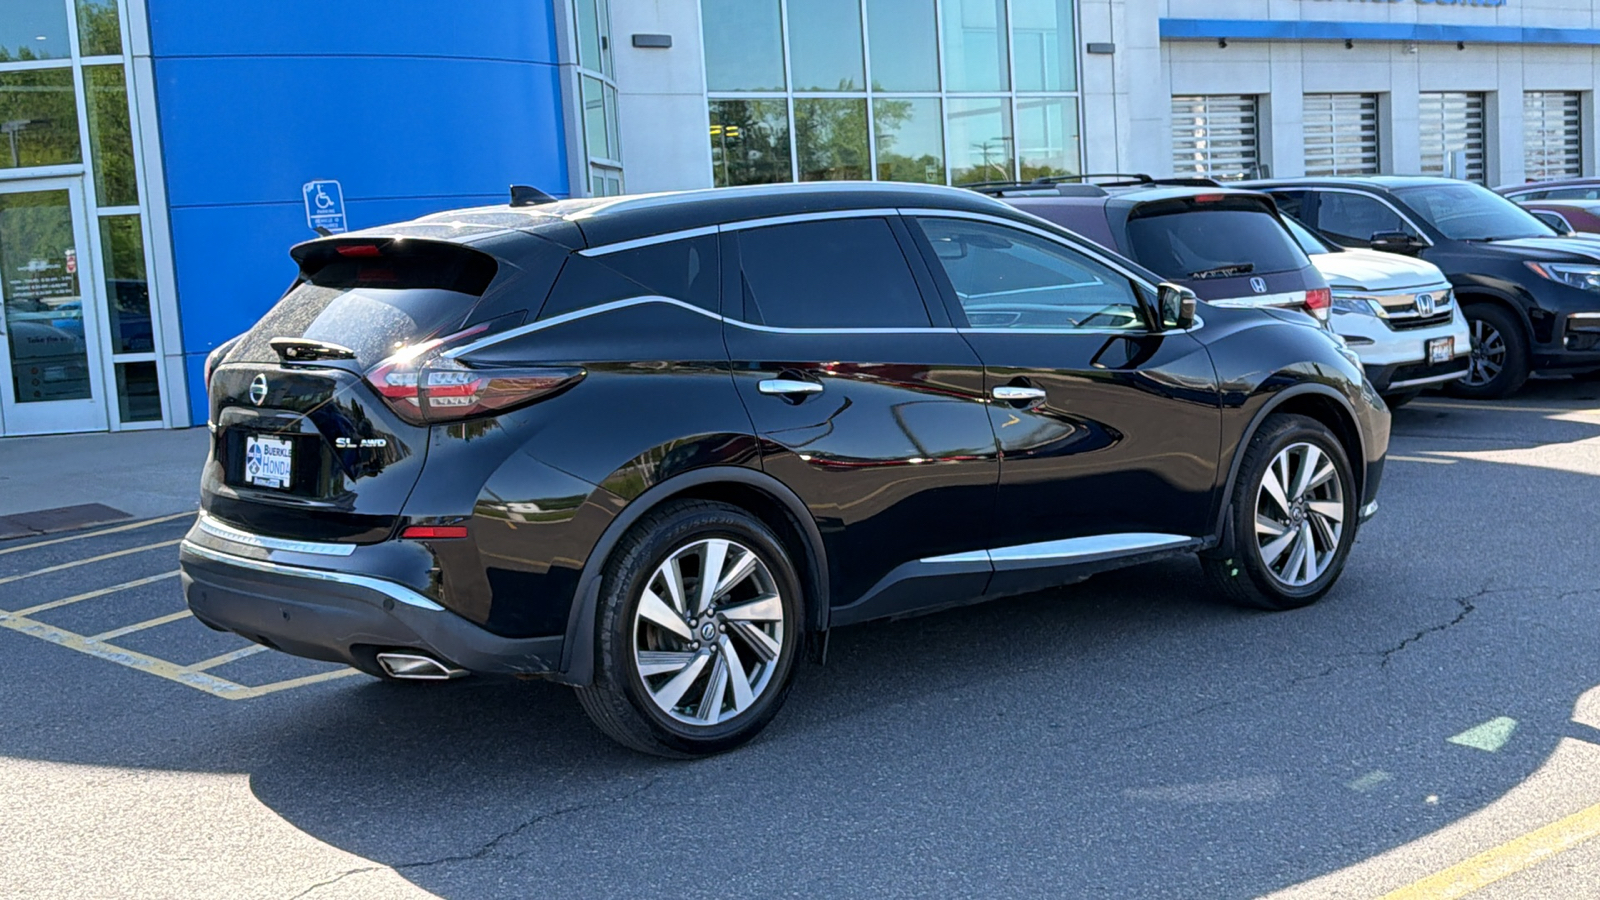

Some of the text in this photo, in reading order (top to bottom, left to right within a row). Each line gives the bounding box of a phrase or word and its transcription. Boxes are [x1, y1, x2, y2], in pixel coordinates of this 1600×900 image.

[335, 437, 387, 449] SL AWD
[264, 444, 292, 457] BUERKLE
[263, 457, 290, 475] HONDA
